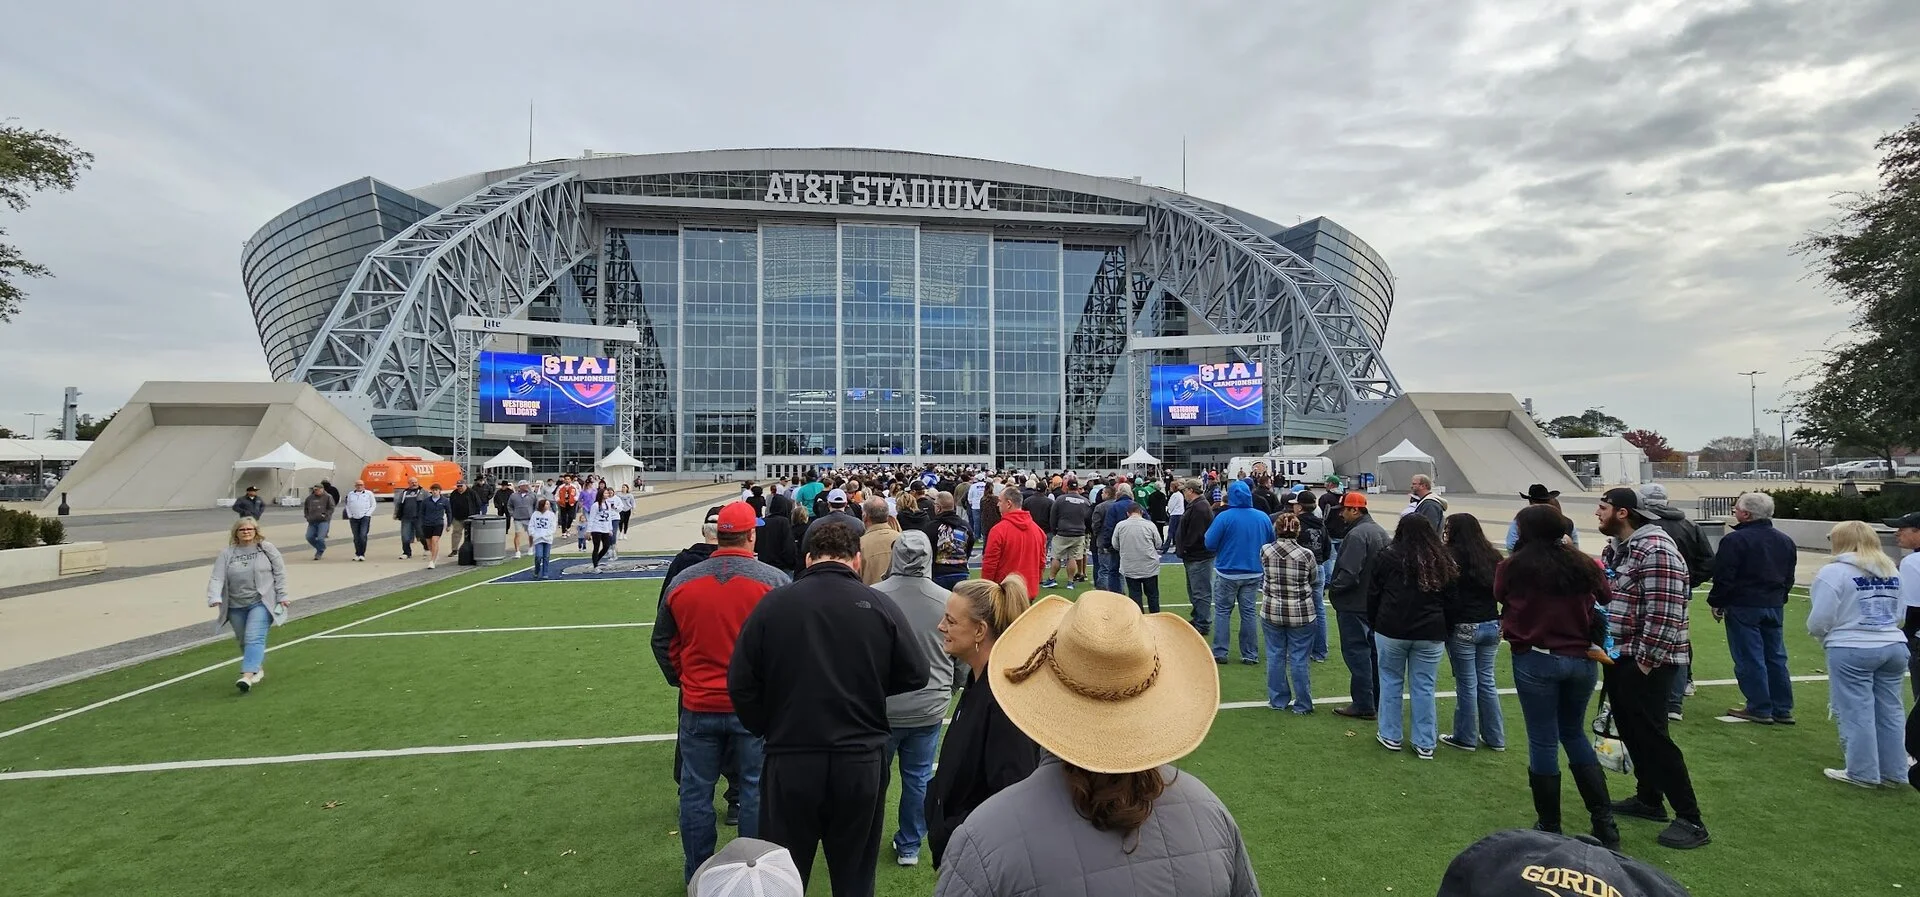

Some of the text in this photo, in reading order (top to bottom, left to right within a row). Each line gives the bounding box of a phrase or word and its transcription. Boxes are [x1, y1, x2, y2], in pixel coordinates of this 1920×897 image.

[764, 172, 991, 210] AT&T STADIUM
[483, 319, 501, 329] Lite
[1256, 334, 1271, 343] Lite
[502, 399, 541, 409] WESTBROOK
[505, 407, 538, 417] WILDCATS
[1171, 411, 1197, 420] WILDCATS
[412, 464, 434, 474] VIZZY
